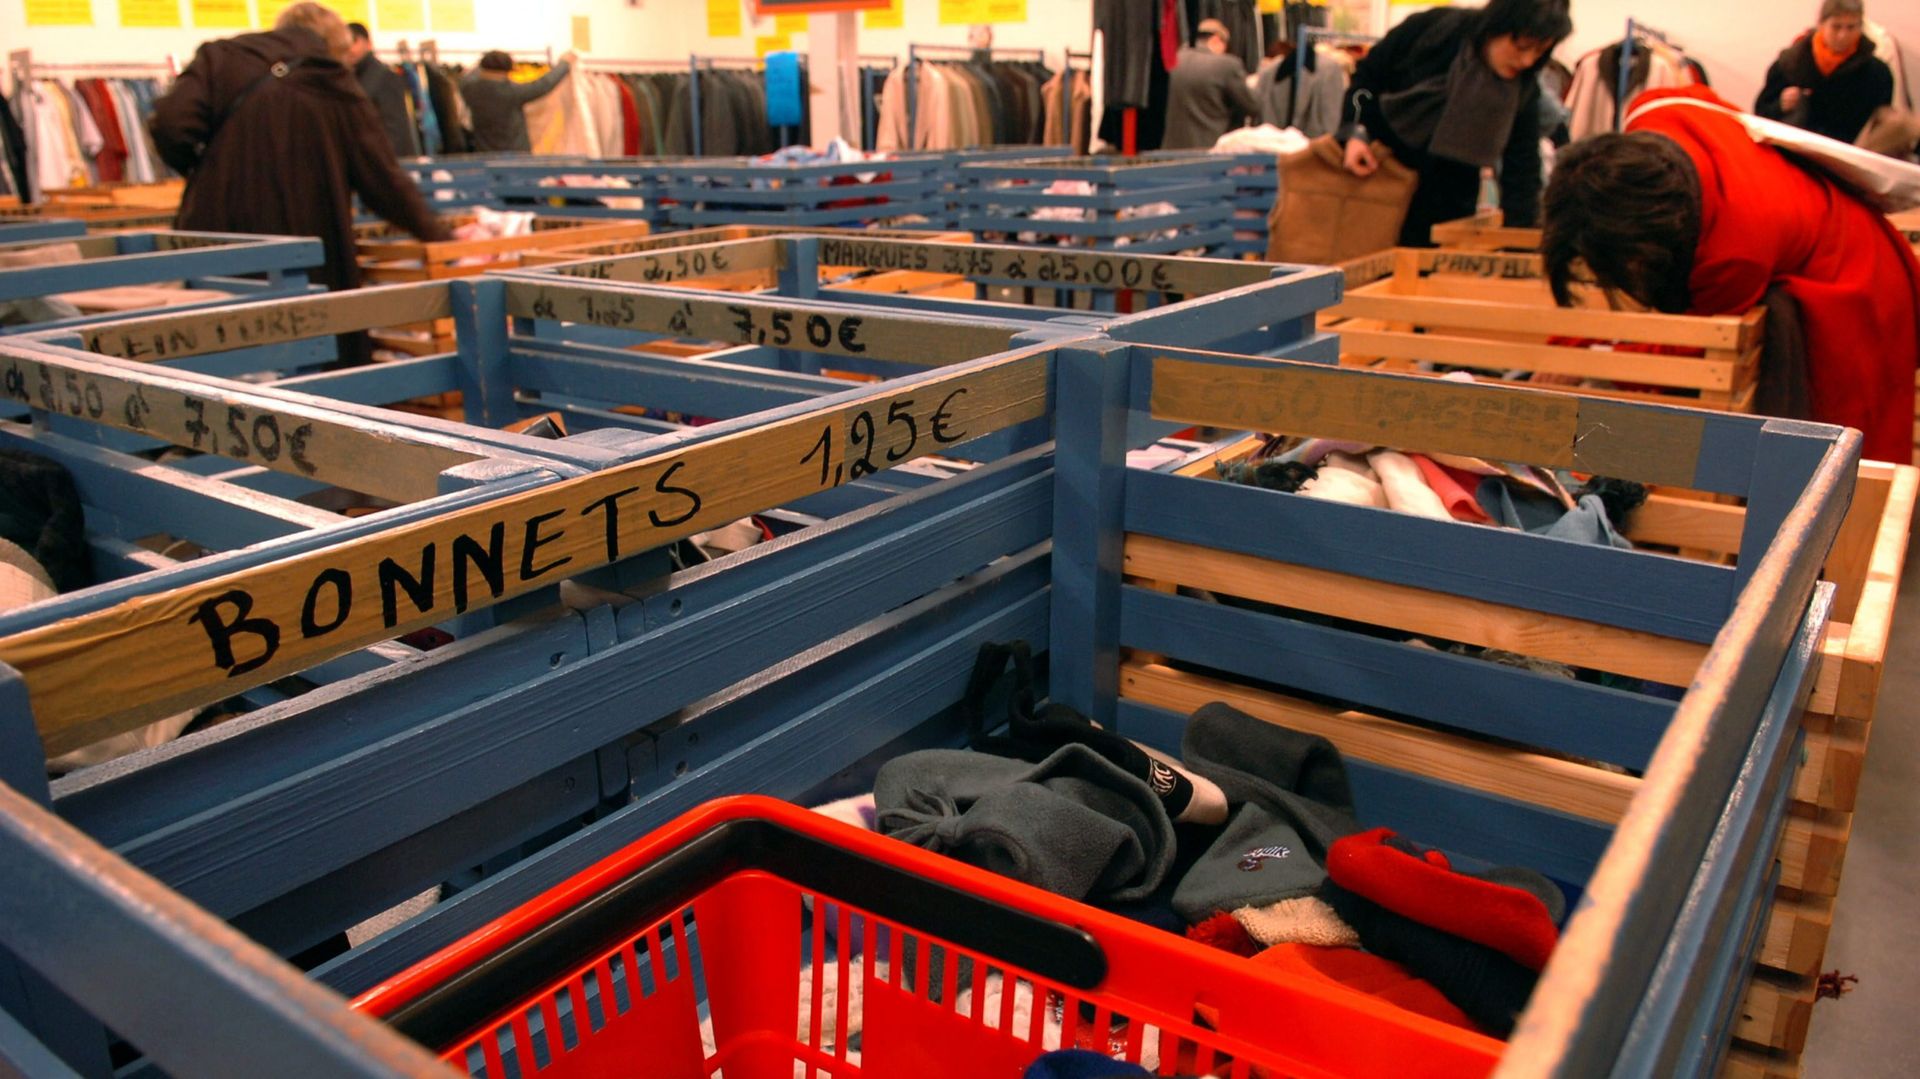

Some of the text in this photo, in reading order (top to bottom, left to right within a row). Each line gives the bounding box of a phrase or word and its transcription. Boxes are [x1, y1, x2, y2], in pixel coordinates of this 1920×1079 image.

[823, 240, 930, 269] MARQUES
[729, 303, 867, 352] 7,50€
[183, 395, 319, 476] 7,50€
[189, 388, 967, 678] BONNETS 1,25€
